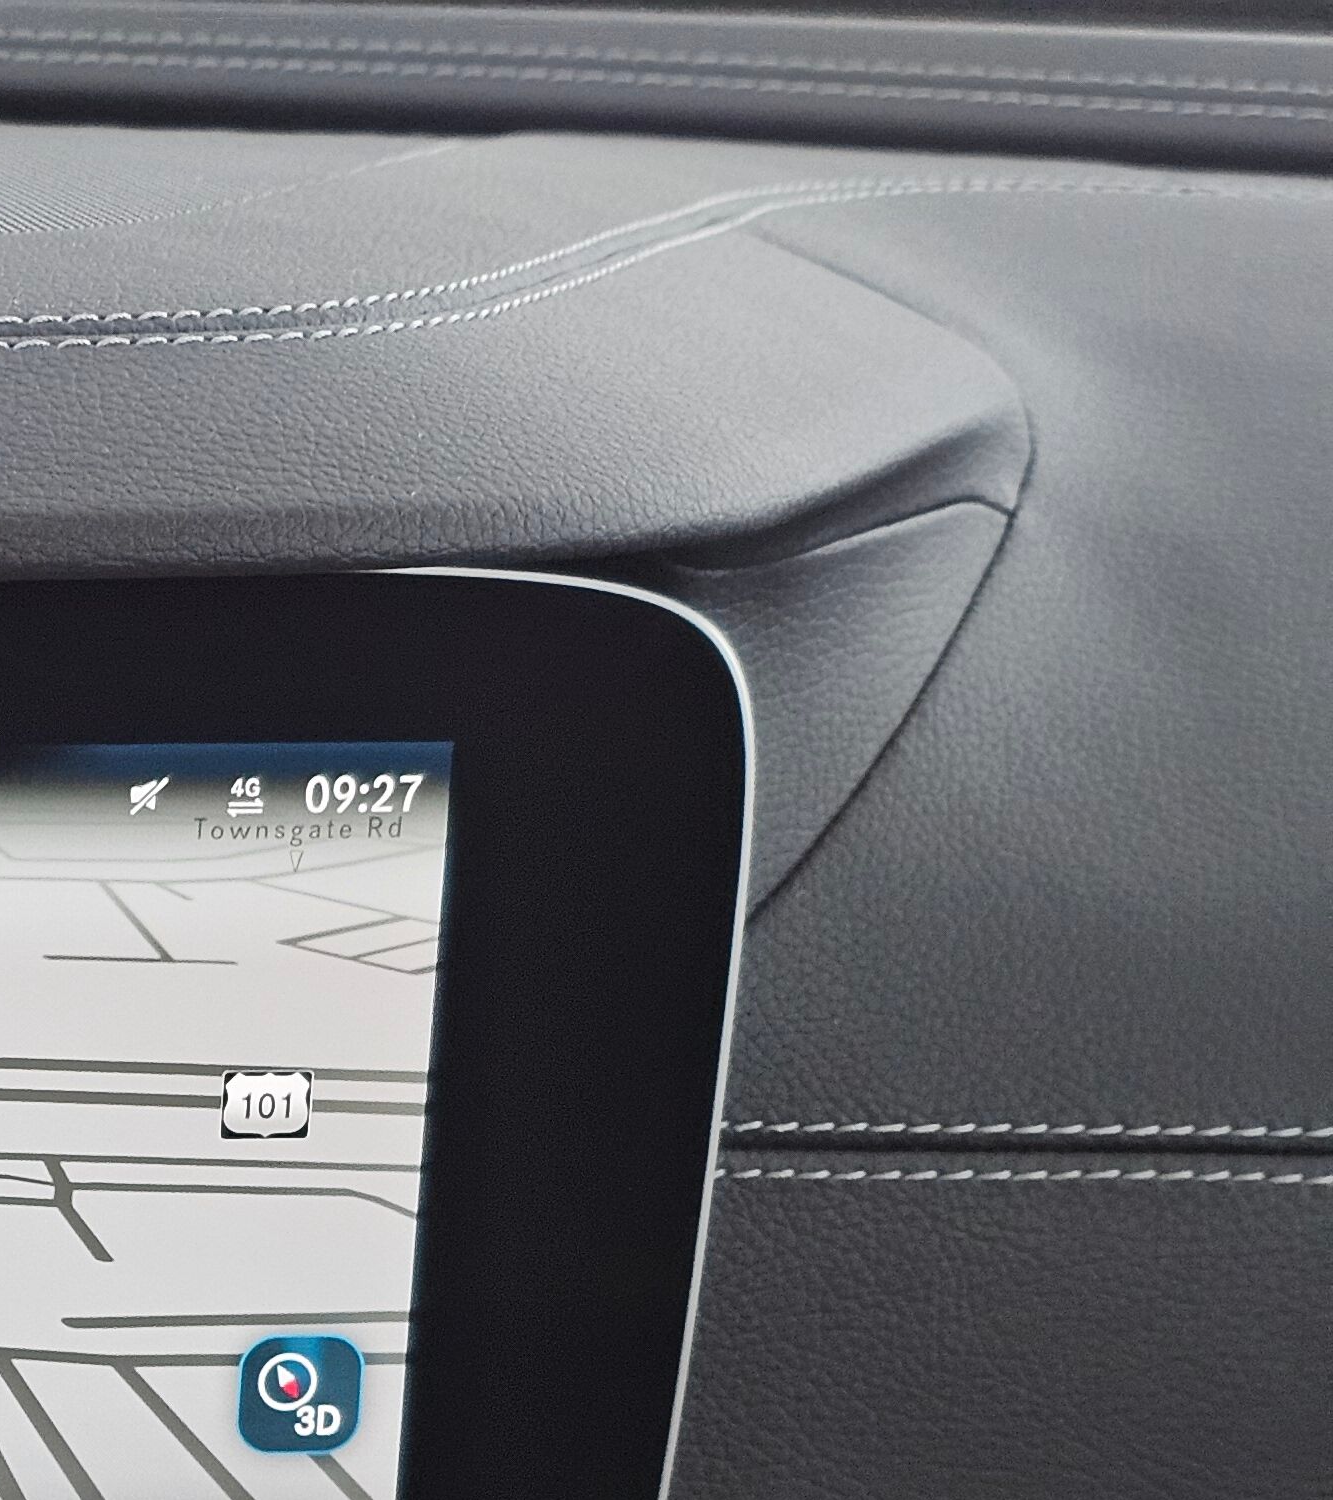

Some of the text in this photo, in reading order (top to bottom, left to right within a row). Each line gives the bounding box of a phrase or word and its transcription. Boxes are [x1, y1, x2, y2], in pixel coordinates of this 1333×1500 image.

[231, 778, 260, 797] 4G
[304, 774, 424, 814] 09:27
[194, 816, 403, 846] Townsgate Rd
[244, 1093, 290, 1119] 101
[294, 1407, 342, 1436] 3D
